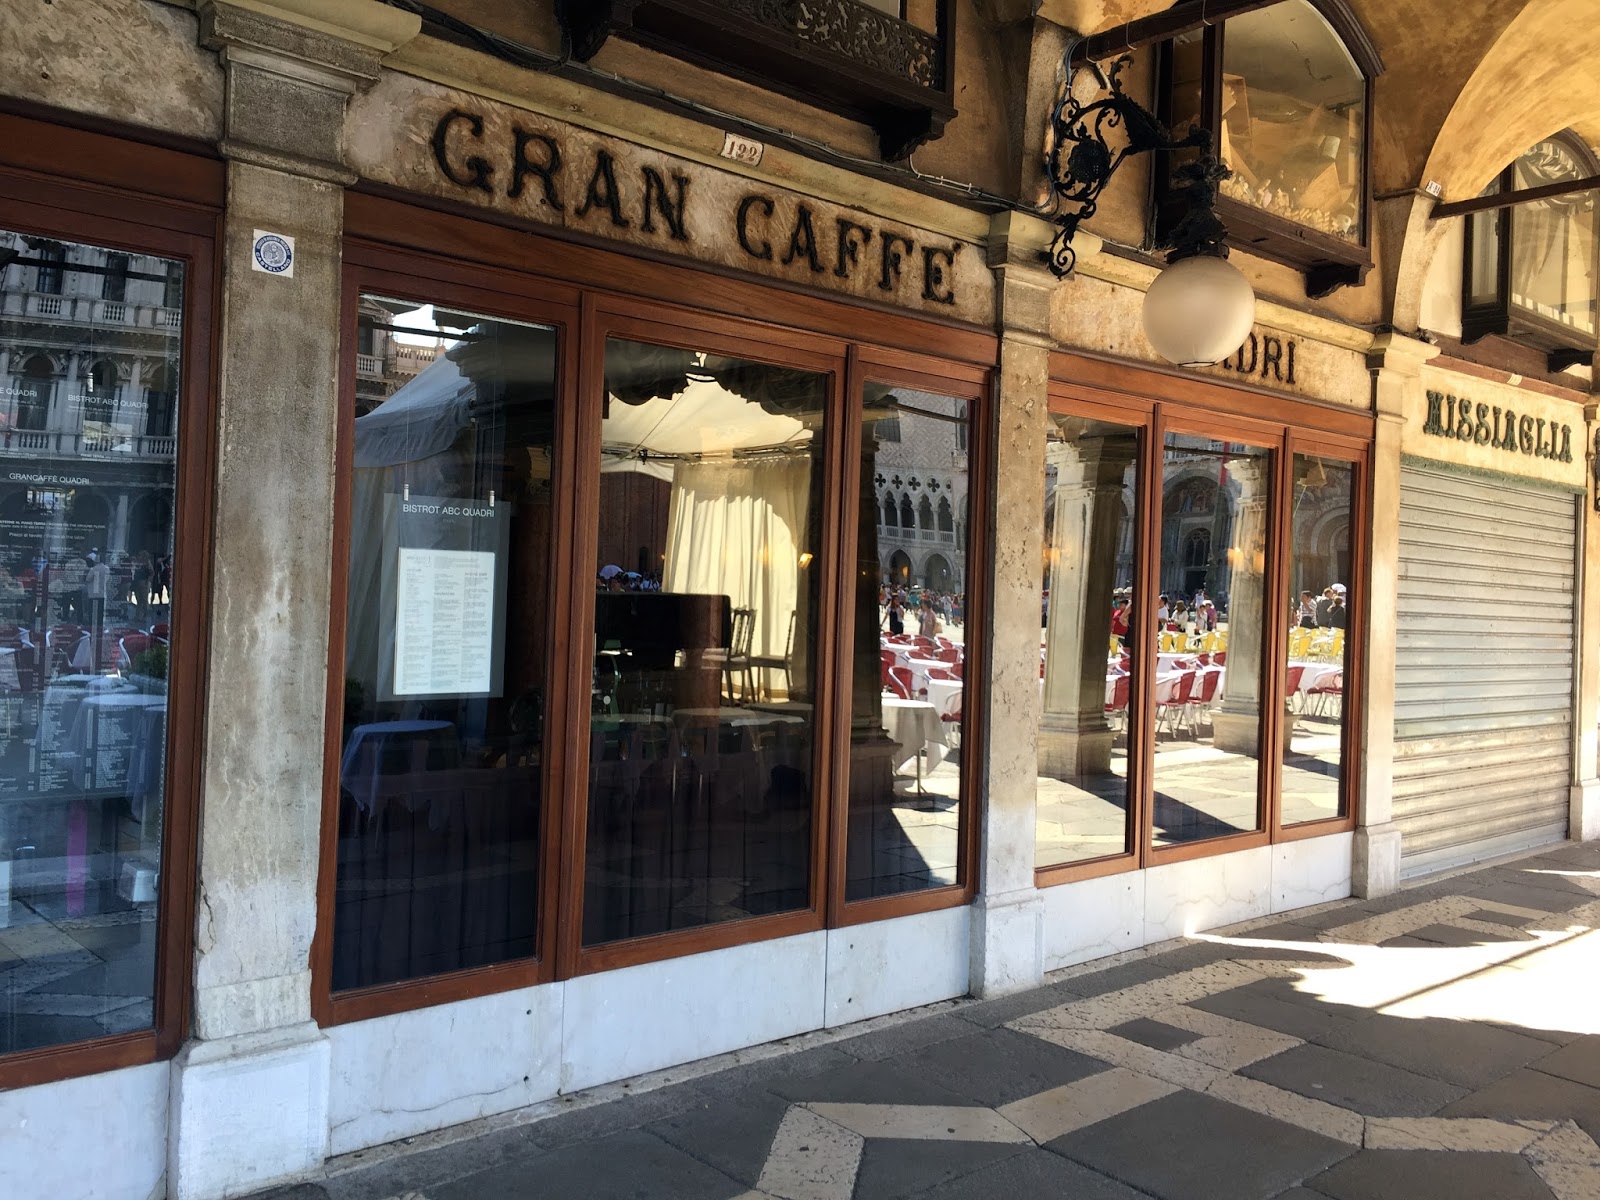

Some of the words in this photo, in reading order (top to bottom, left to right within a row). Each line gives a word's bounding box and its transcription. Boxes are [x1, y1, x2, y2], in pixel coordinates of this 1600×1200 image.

[727, 141, 758, 162] 122
[430, 109, 690, 240] GRAN
[1215, 331, 1296, 384] DRI
[5, 387, 38, 398] QUADRI
[67, 394, 102, 404] BISTROT
[1423, 389, 1573, 464] MISSIAGLIA
[59, 476, 90, 485] QUADRI
[402, 503, 440, 514] BISTROT
[441, 506, 461, 515] ABC
[462, 508, 495, 518] QUADRI
